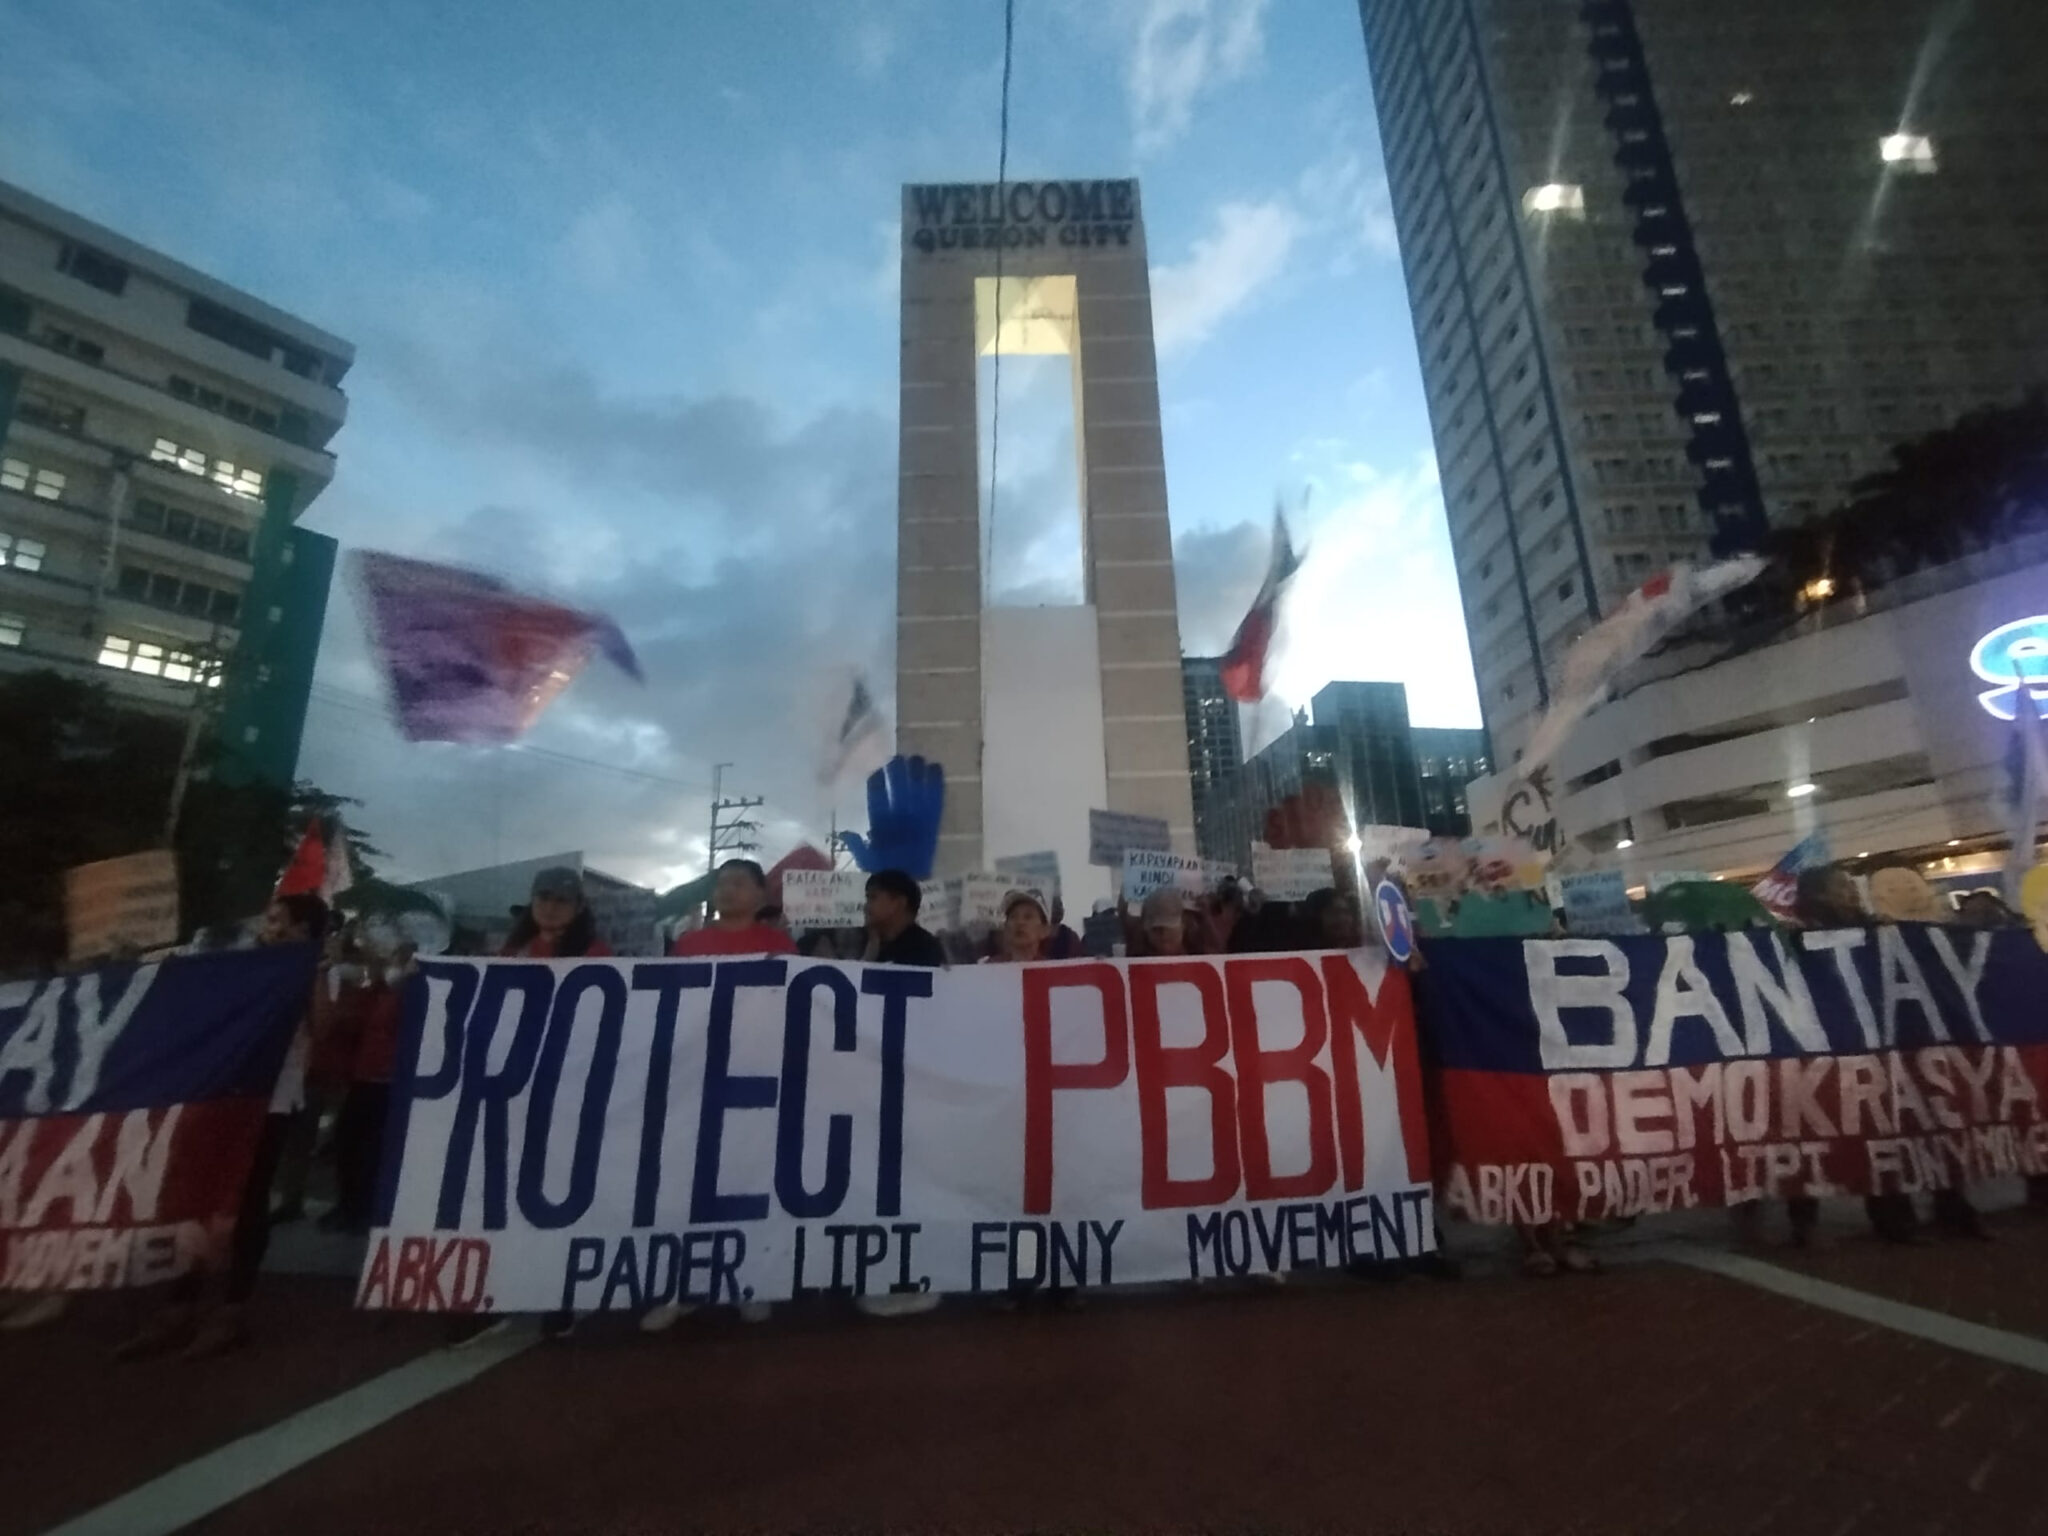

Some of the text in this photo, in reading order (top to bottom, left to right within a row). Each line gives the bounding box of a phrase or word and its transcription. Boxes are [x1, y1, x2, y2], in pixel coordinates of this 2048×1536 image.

[911, 179, 1134, 225] WELCOME
[911, 223, 1133, 253] QUEZON CITY
[1523, 925, 1994, 1071] BANTAY
[370, 959, 933, 1231] PROTECT
[1022, 955, 1431, 1216] PBBM
[1546, 1045, 2041, 1158] DEMOKRASYA
[361, 1235, 494, 1311] ABKD.
[560, 1228, 755, 1310] PADER.
[971, 1218, 1125, 1292] FDNY
[1186, 1189, 1432, 1280] MOVEMENT
